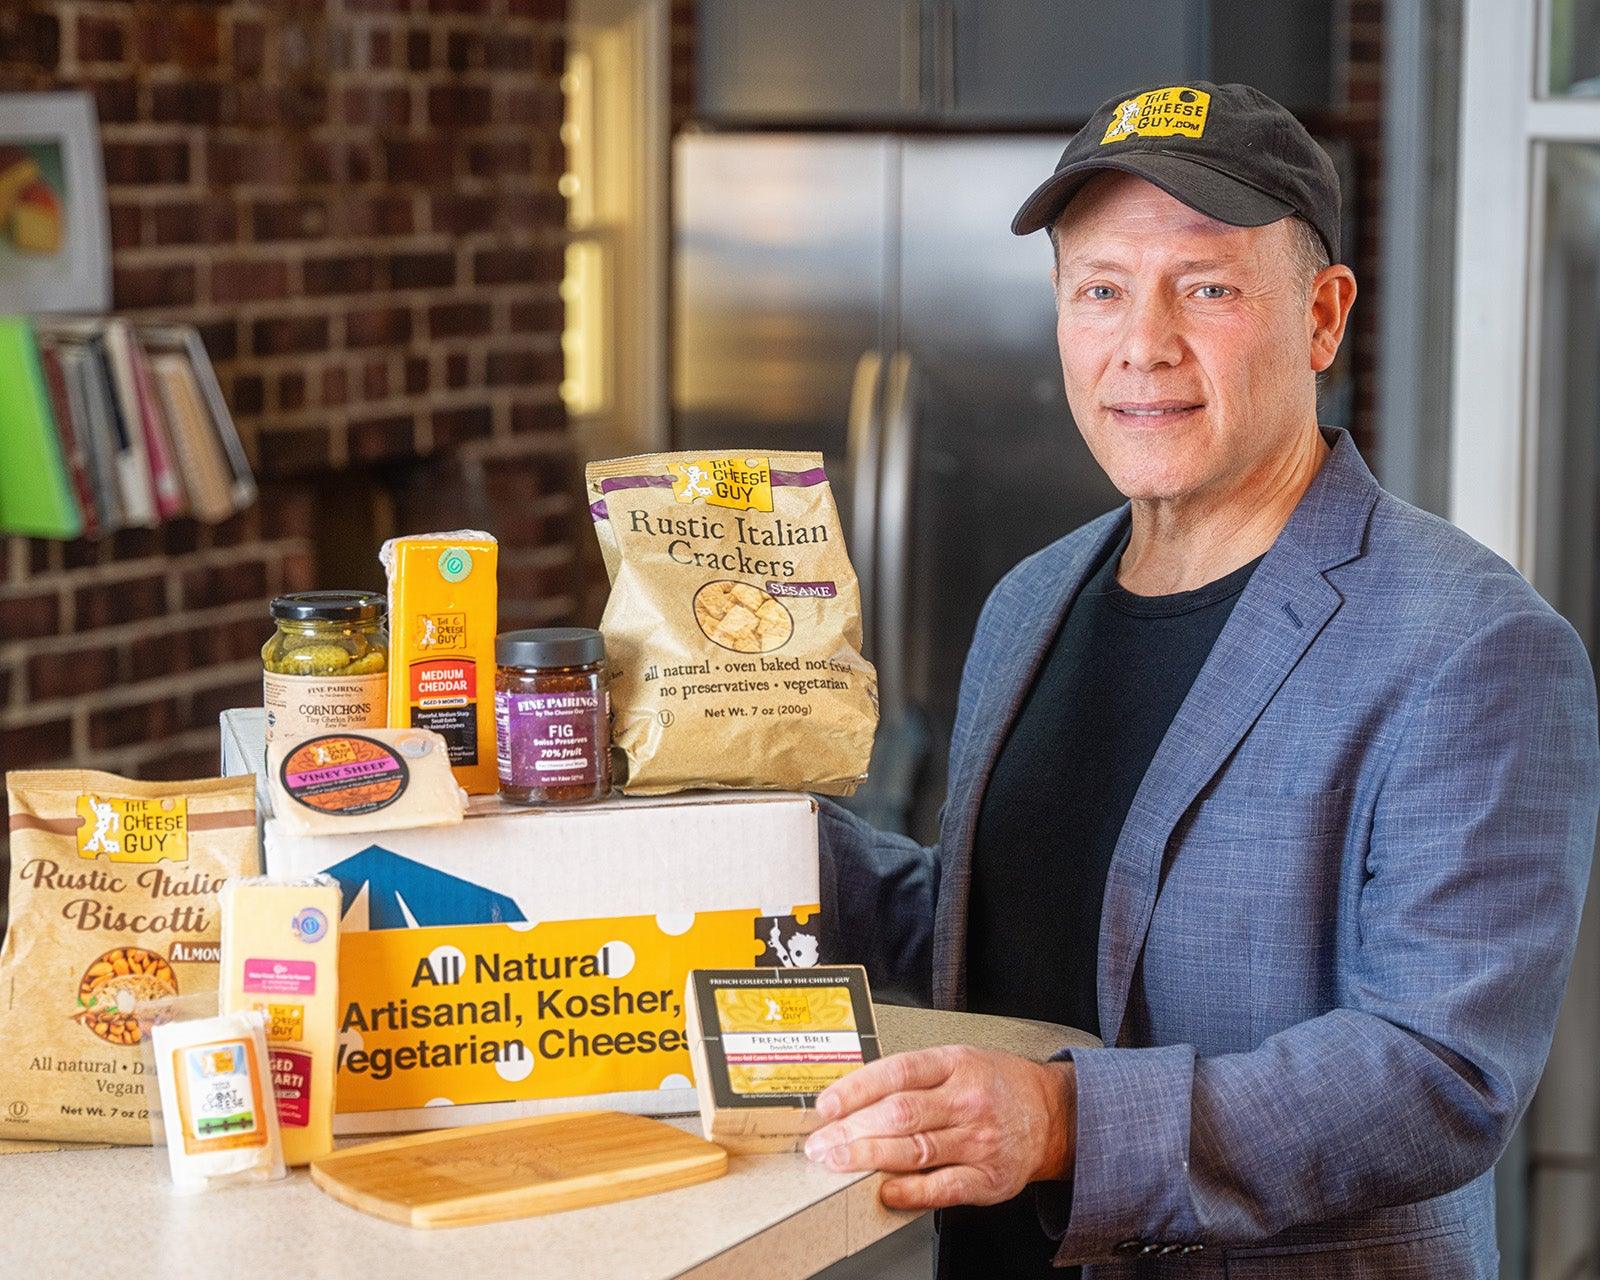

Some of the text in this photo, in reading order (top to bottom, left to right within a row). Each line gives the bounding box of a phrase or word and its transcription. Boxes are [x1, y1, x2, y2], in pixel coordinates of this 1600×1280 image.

[1144, 91, 1171, 105] THE
[1141, 103, 1204, 117] CHEESE
[710, 459, 734, 472] THE
[712, 468, 768, 486] CHEESE
[716, 482, 754, 503] GUY
[627, 509, 828, 547] Rustic Italian
[668, 540, 794, 578] Crackers
[769, 582, 833, 597] SESAME
[437, 626, 464, 635] CHEESE
[437, 635, 458, 645] GUY
[421, 669, 464, 681] MEDIUM
[645, 665, 659, 682] all
[663, 660, 710, 678] natural
[724, 662, 757, 674] oven
[760, 657, 800, 673] baked
[805, 659, 828, 671] not
[307, 685, 364, 694] FINE PAIRINGS
[418, 680, 468, 693] CHEDDAR
[660, 677, 849, 701] no preservatives vegetarian
[298, 703, 372, 716] CORNICHONS
[517, 696, 599, 712] FINE PAIRINGS
[704, 704, 813, 718] Net Wt. 7 oz (200g)
[321, 715, 346, 724] Gherkin
[347, 714, 367, 723] Pickles
[574, 708, 585, 716] Guy
[548, 724, 574, 738] FIG
[555, 736, 588, 746] Preserves
[541, 747, 583, 759] 70% fruit
[297, 769, 341, 783] VINEY
[344, 762, 386, 776] SHEEP
[123, 801, 149, 813] THE
[123, 814, 184, 832] CHEESE
[124, 833, 169, 854] GUY
[19, 858, 128, 894] Rustic
[62, 898, 211, 934] Biscotti
[411, 947, 611, 988] All Natural
[739, 978, 783, 986] COLLECTION
[793, 977, 808, 985] THE
[808, 977, 834, 985] CHEESE
[835, 976, 851, 984] GUY
[341, 986, 681, 1034] Artisanal, Kosher,
[271, 1025, 294, 1037] GUY
[751, 1035, 832, 1045] FRENCH BRIE
[29, 1057, 53, 1072] All
[57, 1058, 117, 1075] natural
[96, 1079, 145, 1098] Vegan
[60, 1104, 83, 1116] Net
[86, 1106, 107, 1117] Wt.
[111, 1107, 118, 1117] 7
[121, 1109, 135, 1119] oz
